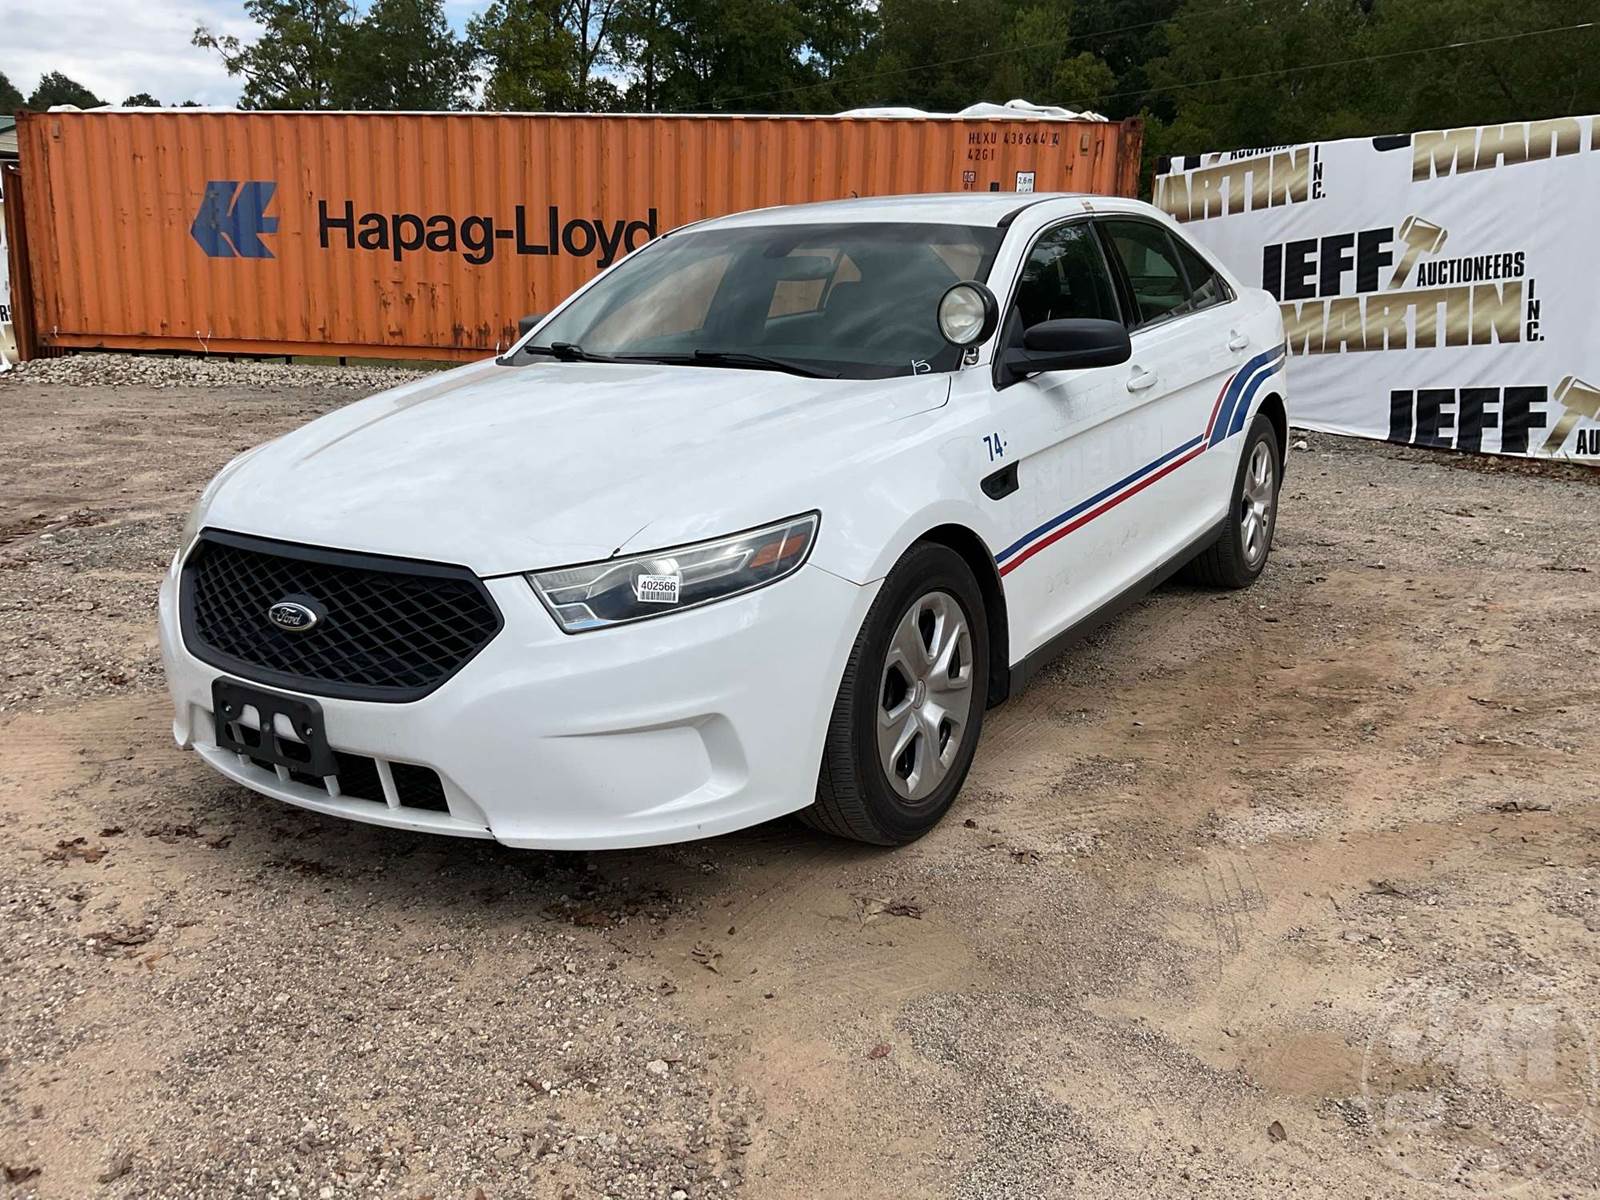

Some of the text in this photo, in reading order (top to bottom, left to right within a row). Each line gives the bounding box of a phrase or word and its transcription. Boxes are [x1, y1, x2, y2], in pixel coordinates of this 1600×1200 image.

[967, 148, 995, 161] 42G1
[968, 132, 997, 145] HLXU
[1153, 148, 1310, 224] ARTIN
[1312, 144, 1326, 200] INC.
[318, 199, 657, 268] Hapag-Lloyd
[1416, 251, 1525, 287] AUCTIONEERS
[1280, 280, 1523, 355] MARTIN
[1526, 278, 1545, 342] INC.
[641, 580, 676, 591] 402566
[273, 606, 303, 625] Ford
